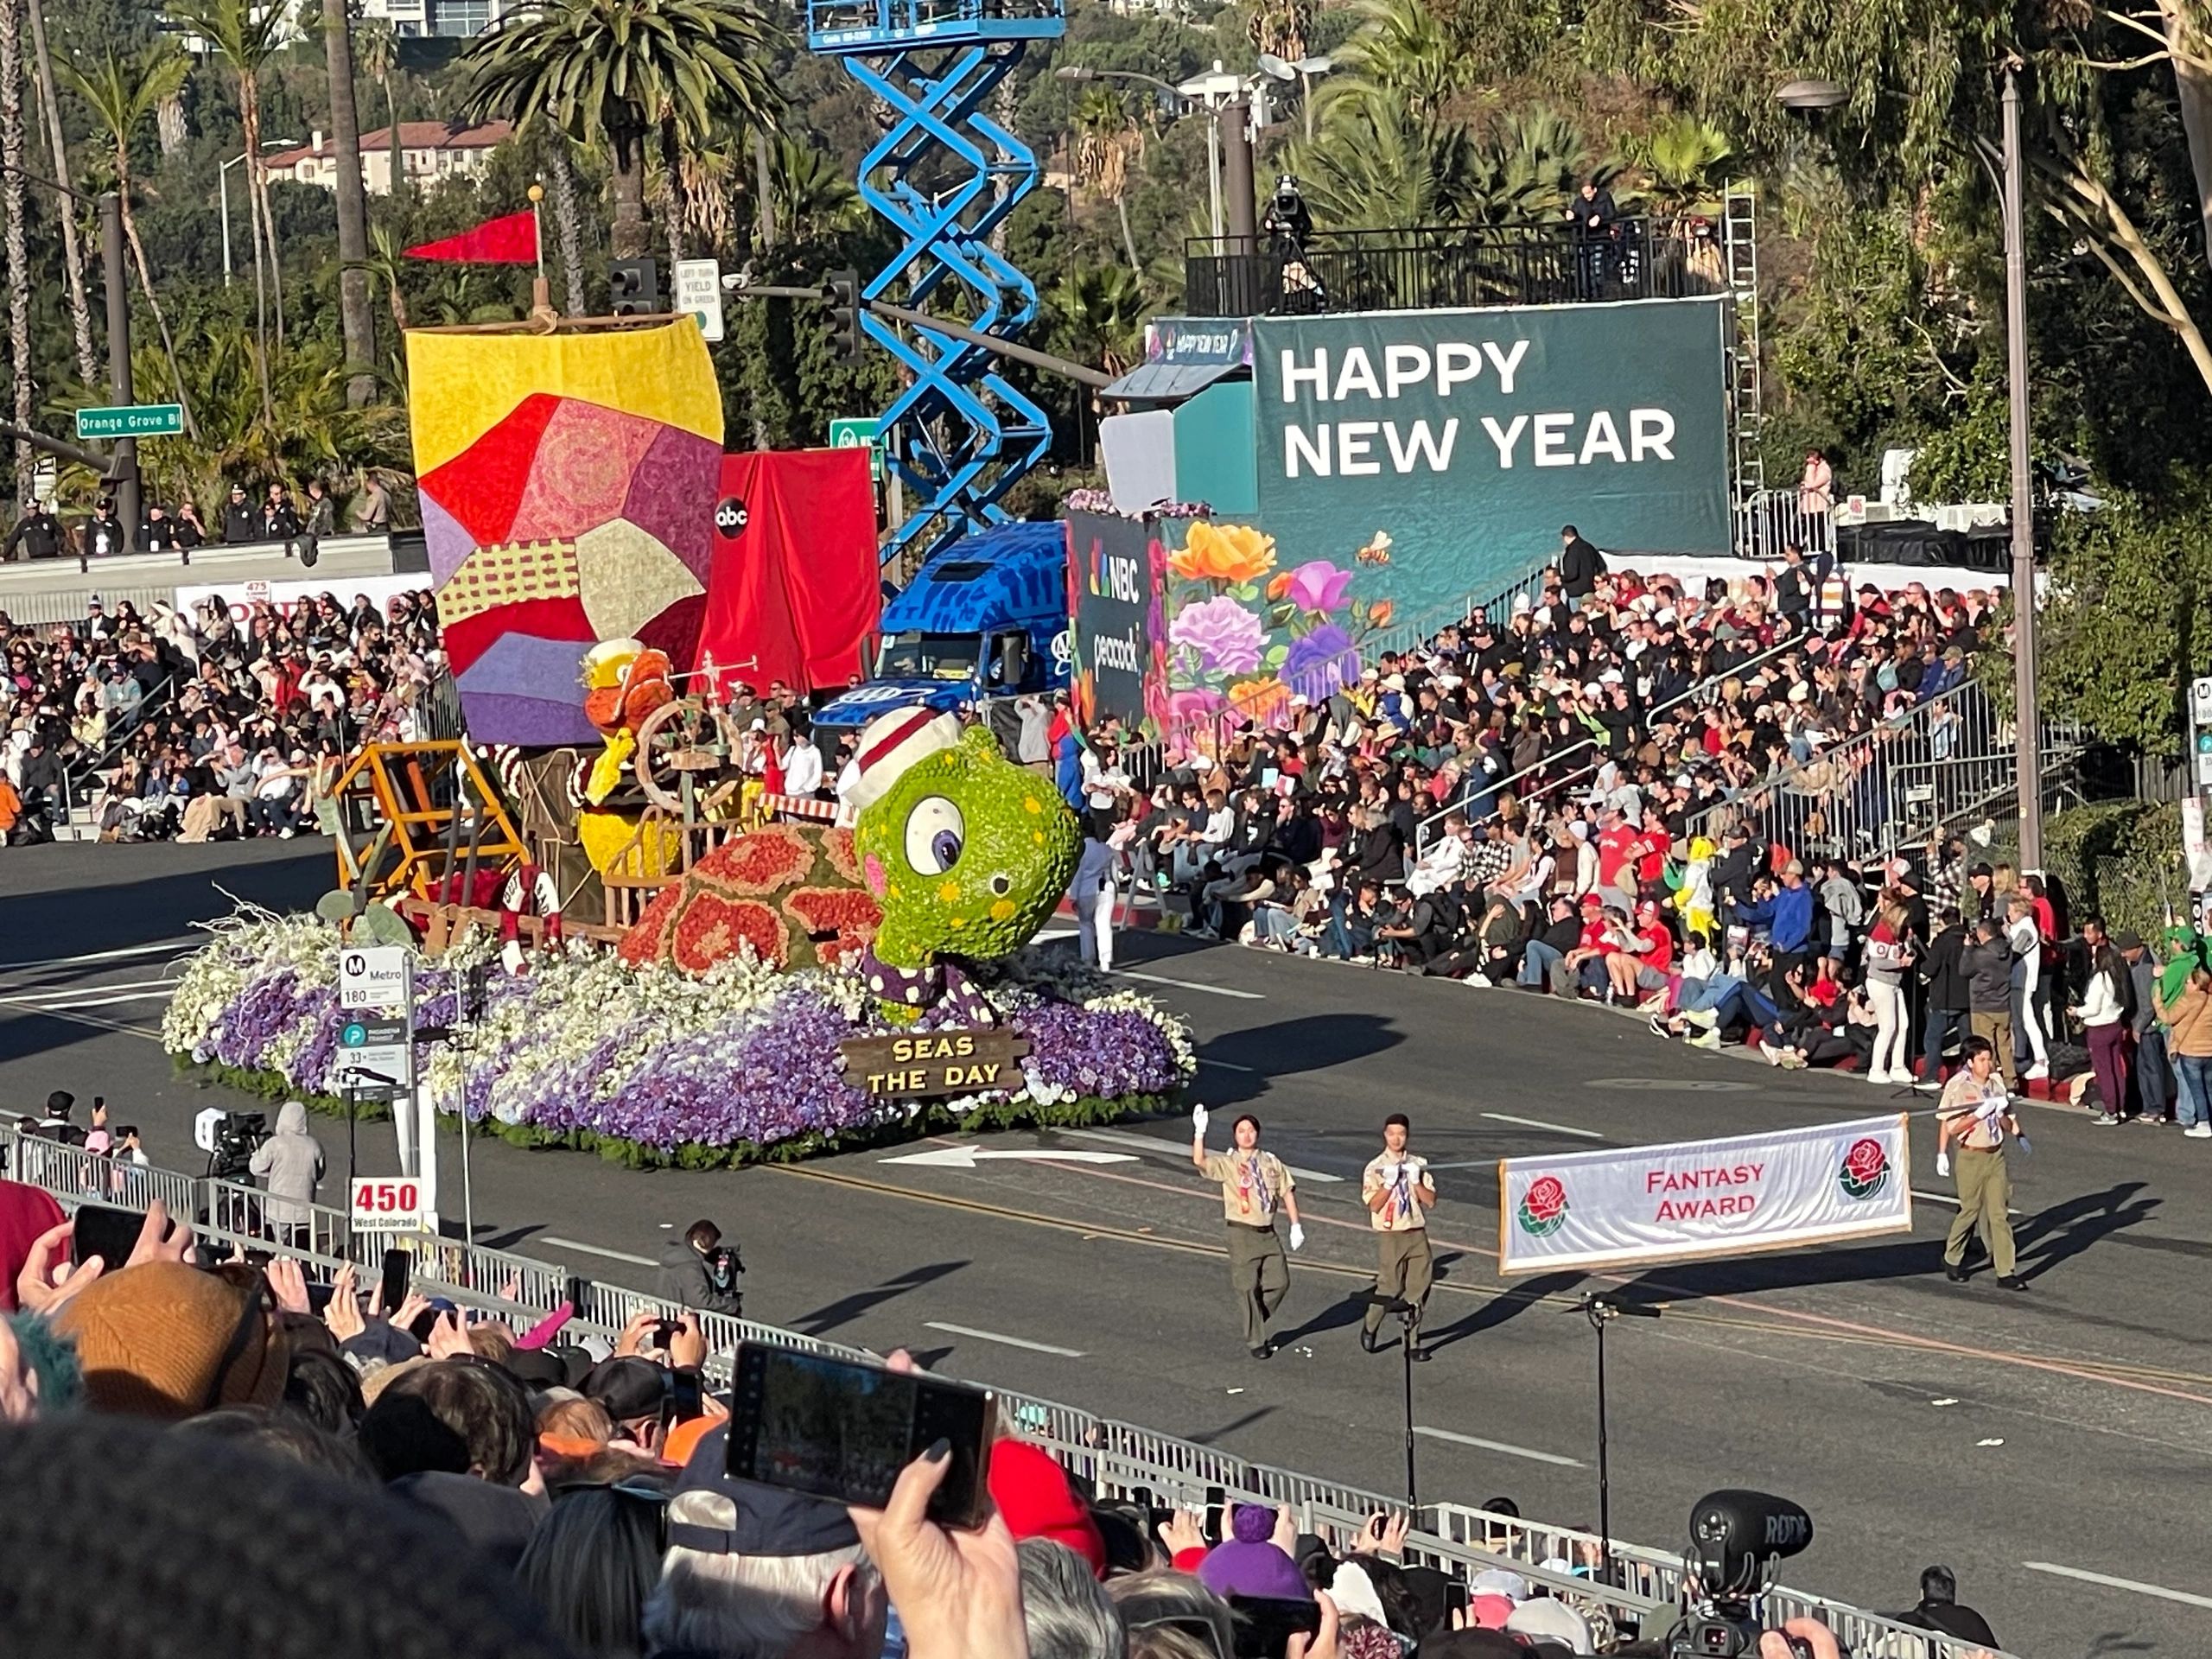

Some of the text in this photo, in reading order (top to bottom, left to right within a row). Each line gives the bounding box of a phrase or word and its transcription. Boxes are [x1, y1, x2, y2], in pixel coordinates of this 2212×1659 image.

[685, 281, 711, 292] YIELD
[1281, 340, 1530, 403] HAPPY
[80, 418, 122, 431] Orange
[128, 416, 162, 427] Grove
[1285, 409, 1675, 478] NEW YEAR
[715, 505, 748, 527] abc
[1109, 556, 1140, 604] NBC
[1094, 627, 1138, 683] peacock
[370, 971, 402, 981] Metro
[346, 990, 366, 1002] 180
[893, 1037, 973, 1063] SEAS
[868, 1064, 1000, 1094] THE DAY
[1647, 1163, 1764, 1194] FANTASY
[355, 1184, 416, 1212] 450
[1655, 1195, 1756, 1222] AWARD
[353, 1217, 417, 1227] West Colorado
